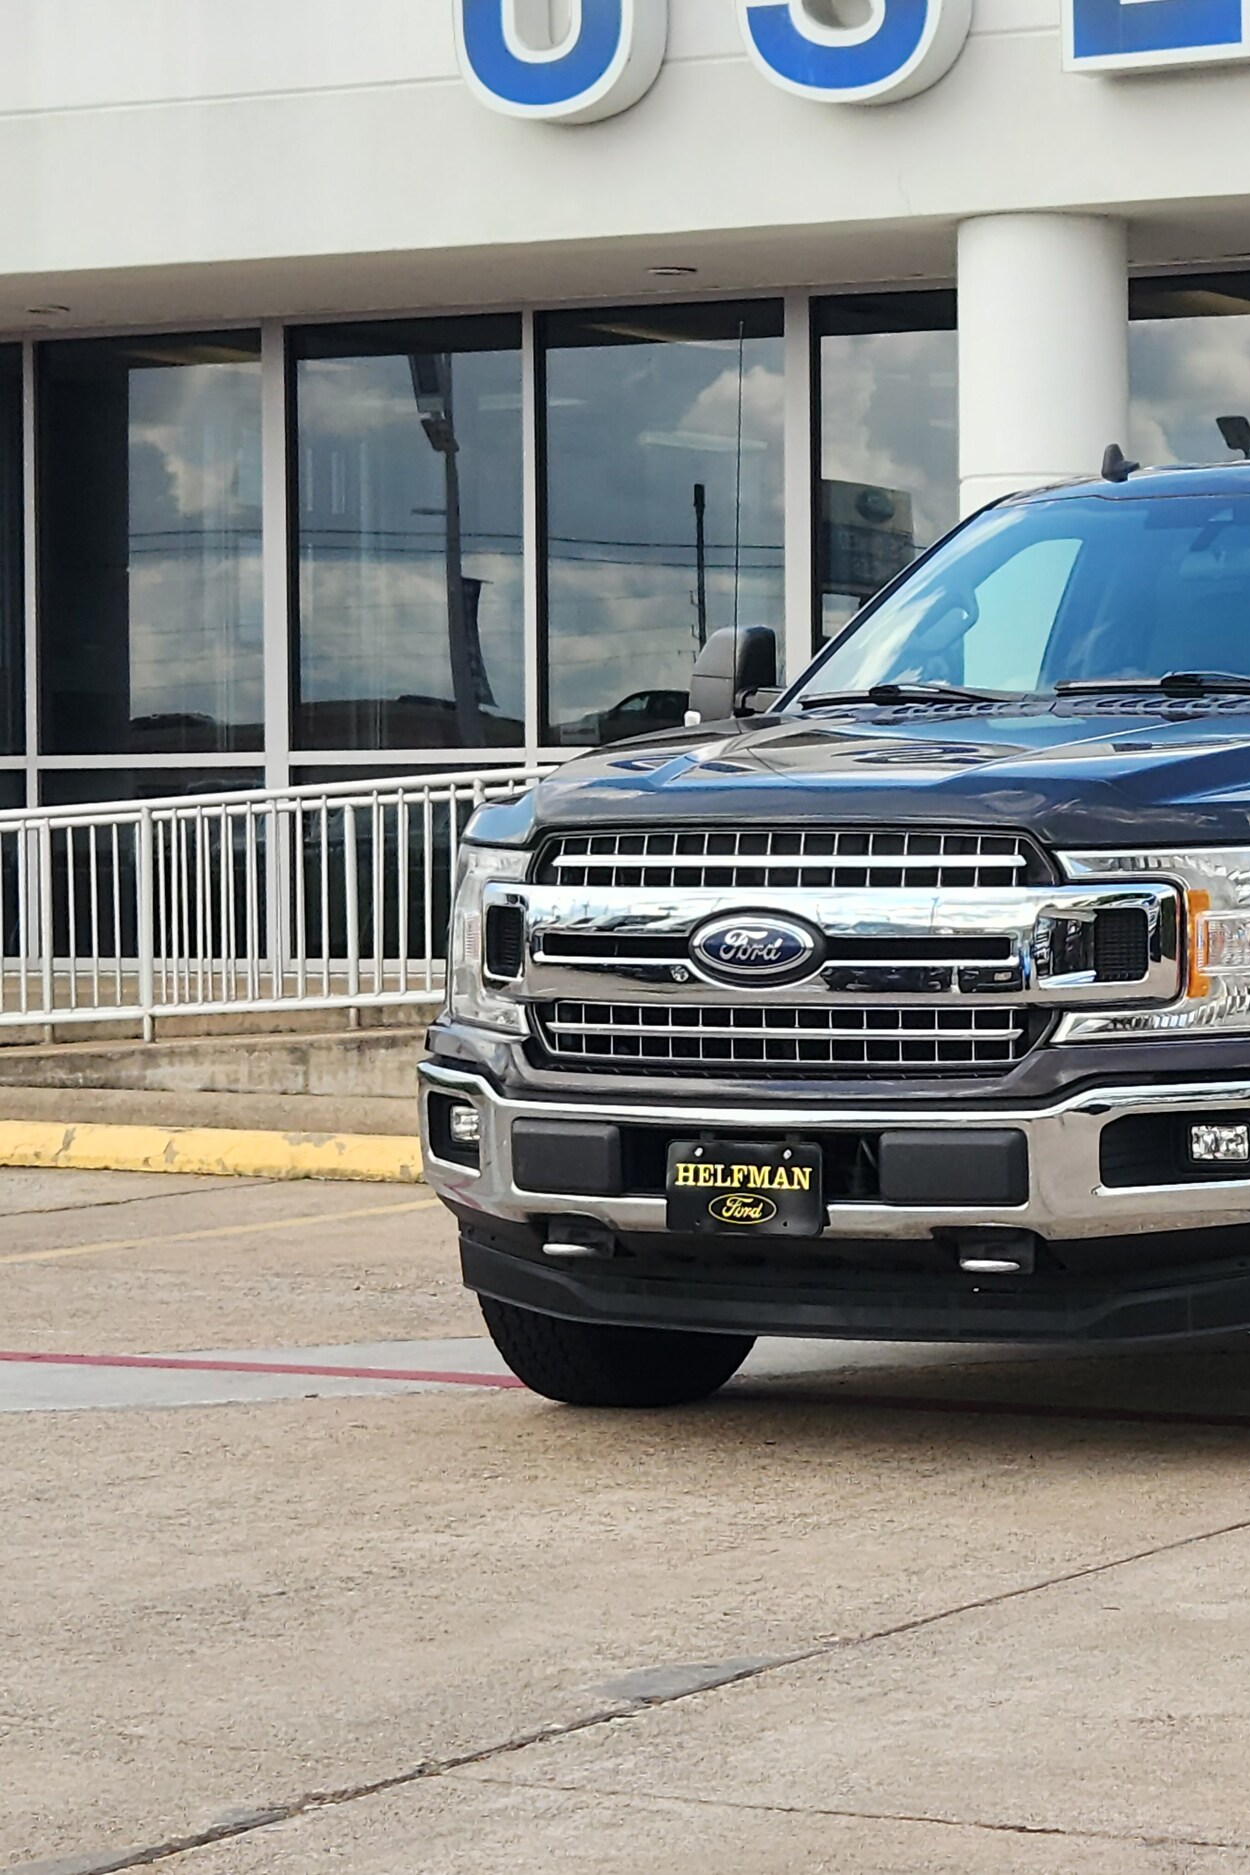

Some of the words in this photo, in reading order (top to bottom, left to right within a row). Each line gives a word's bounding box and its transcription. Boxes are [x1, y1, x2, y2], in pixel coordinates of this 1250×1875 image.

[719, 928, 784, 962] Ford
[674, 1162, 813, 1191] HELFMAN
[721, 1196, 764, 1219] Ford
